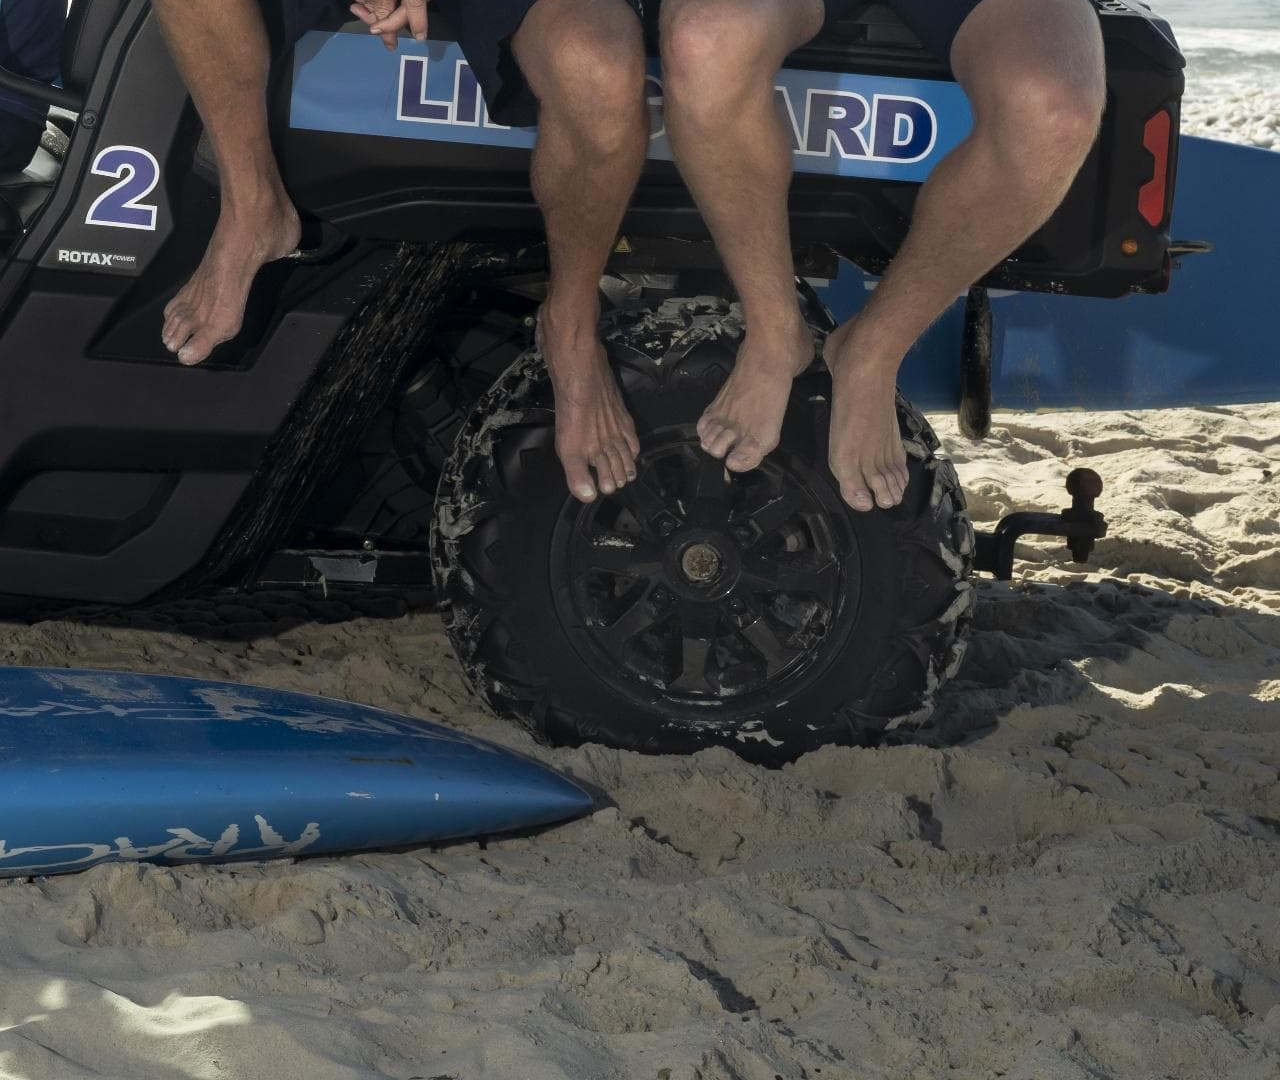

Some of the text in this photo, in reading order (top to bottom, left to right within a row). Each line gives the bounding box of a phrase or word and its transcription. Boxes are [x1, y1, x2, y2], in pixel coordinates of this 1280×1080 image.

[85, 145, 160, 231] 2
[58, 249, 136, 266] ROTAX POWER
